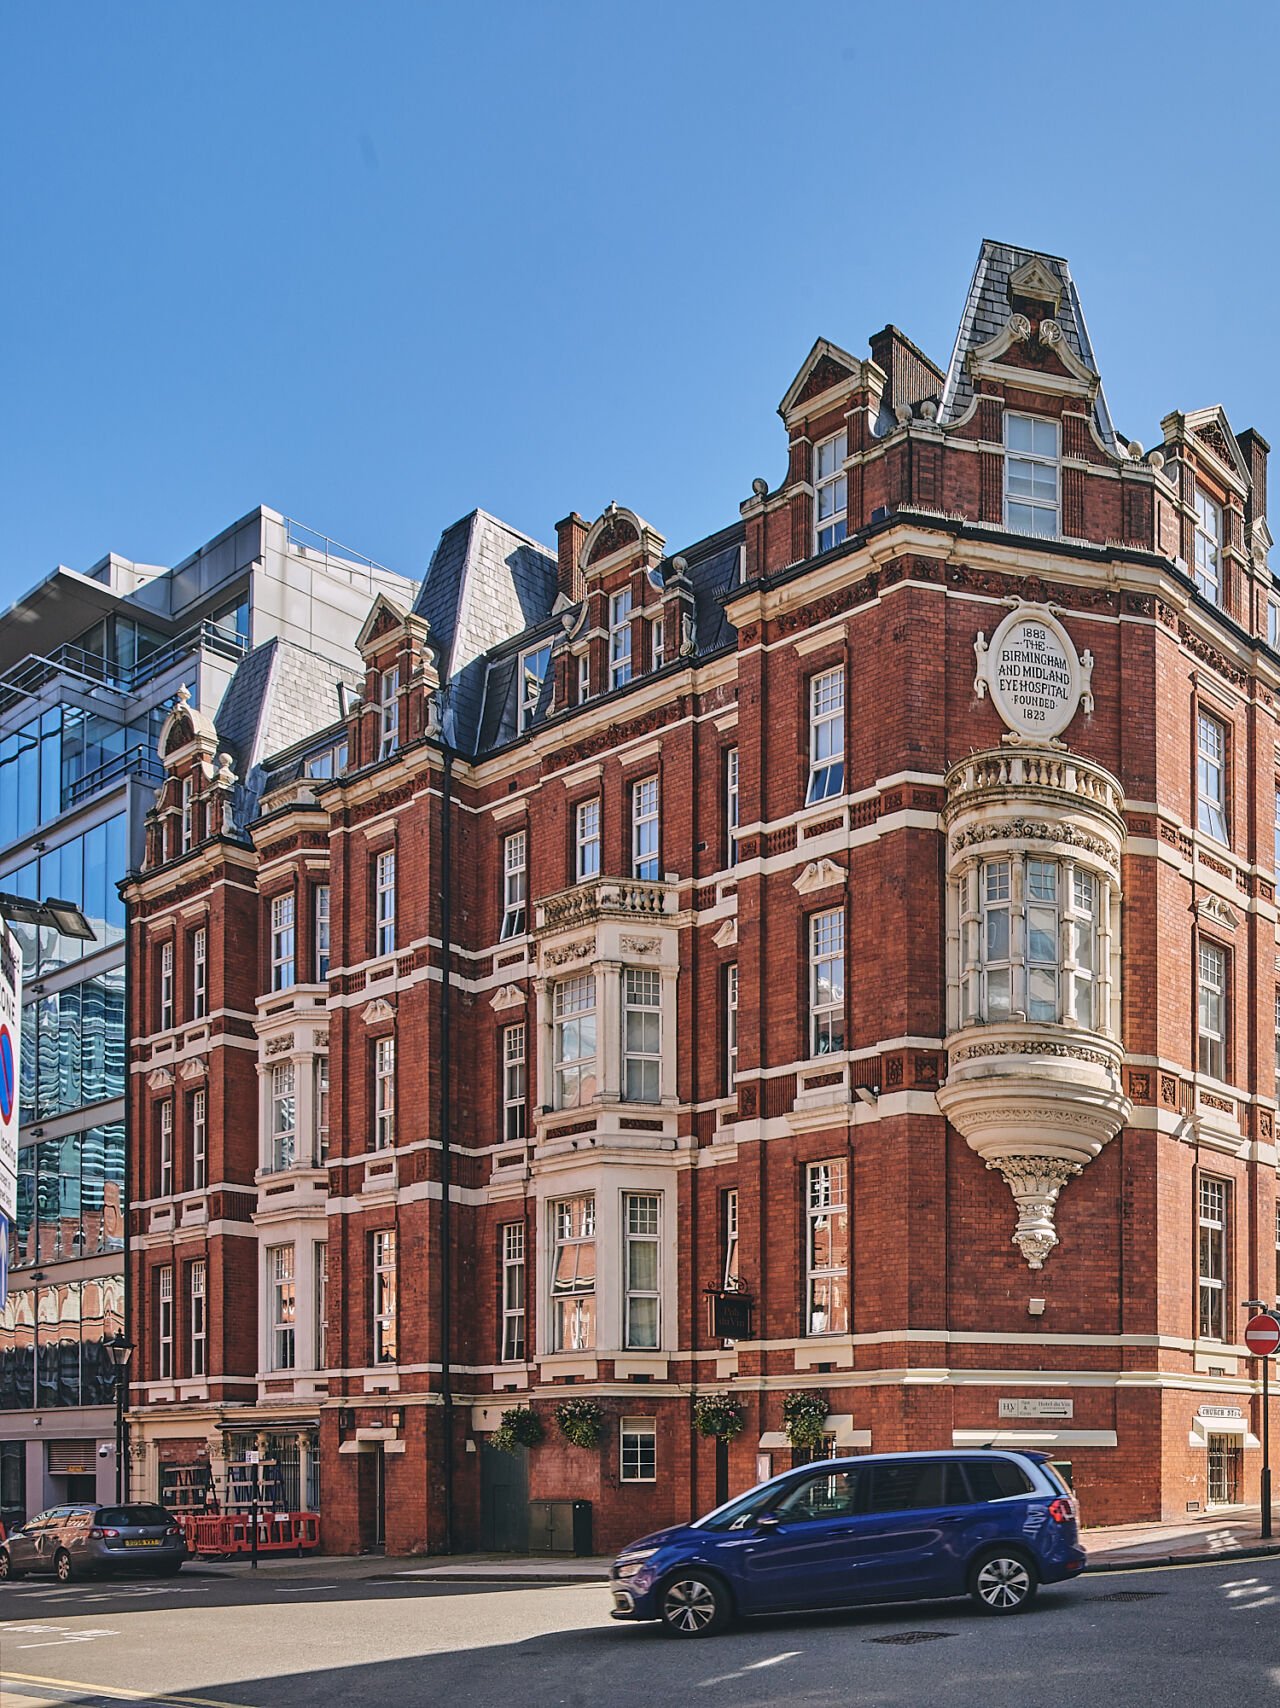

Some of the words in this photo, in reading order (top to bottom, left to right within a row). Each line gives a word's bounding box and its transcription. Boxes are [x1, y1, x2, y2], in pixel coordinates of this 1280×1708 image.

[1023, 628, 1046, 639] 1883
[1023, 640, 1046, 651] THE
[1002, 650, 1067, 671] BIRMINGHAM
[998, 665, 1020, 677] AND
[1022, 666, 1070, 685] MIDLAND
[1000, 679, 1018, 691] EYE
[1019, 681, 1068, 700] HOSPITAL
[1023, 709, 1046, 721] 1823
[0, 982, 15, 1026] ONE
